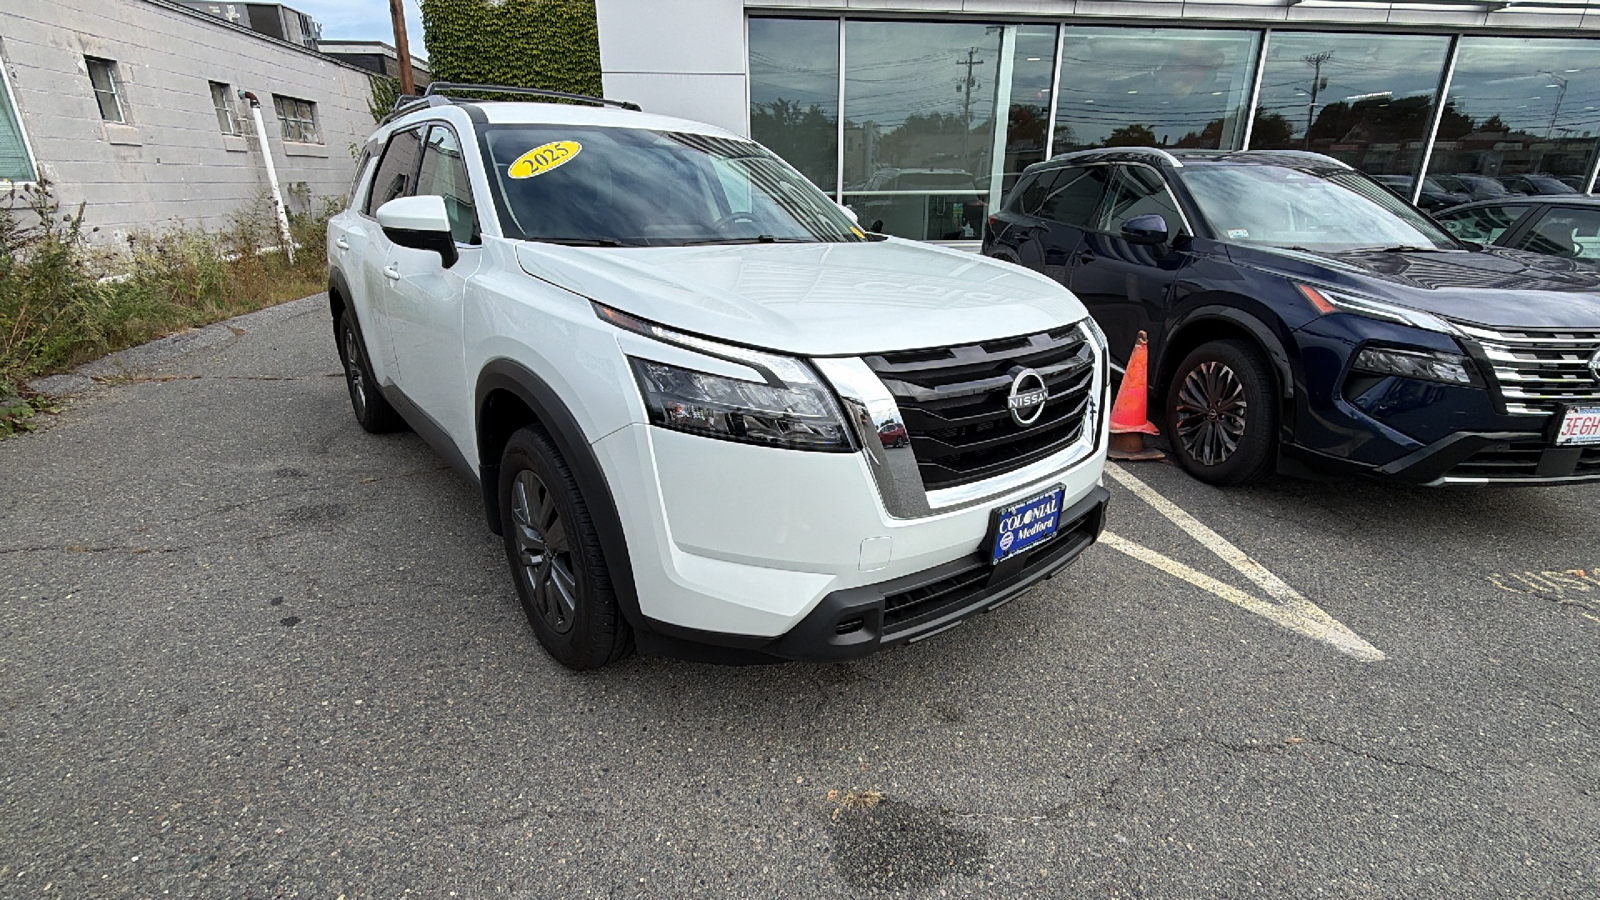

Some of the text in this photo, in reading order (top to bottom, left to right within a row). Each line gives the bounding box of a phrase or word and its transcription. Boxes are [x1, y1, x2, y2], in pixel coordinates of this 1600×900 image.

[522, 143, 569, 173] 2025
[1009, 389, 1049, 408] NISSAN
[1017, 516, 1054, 542] Medford
